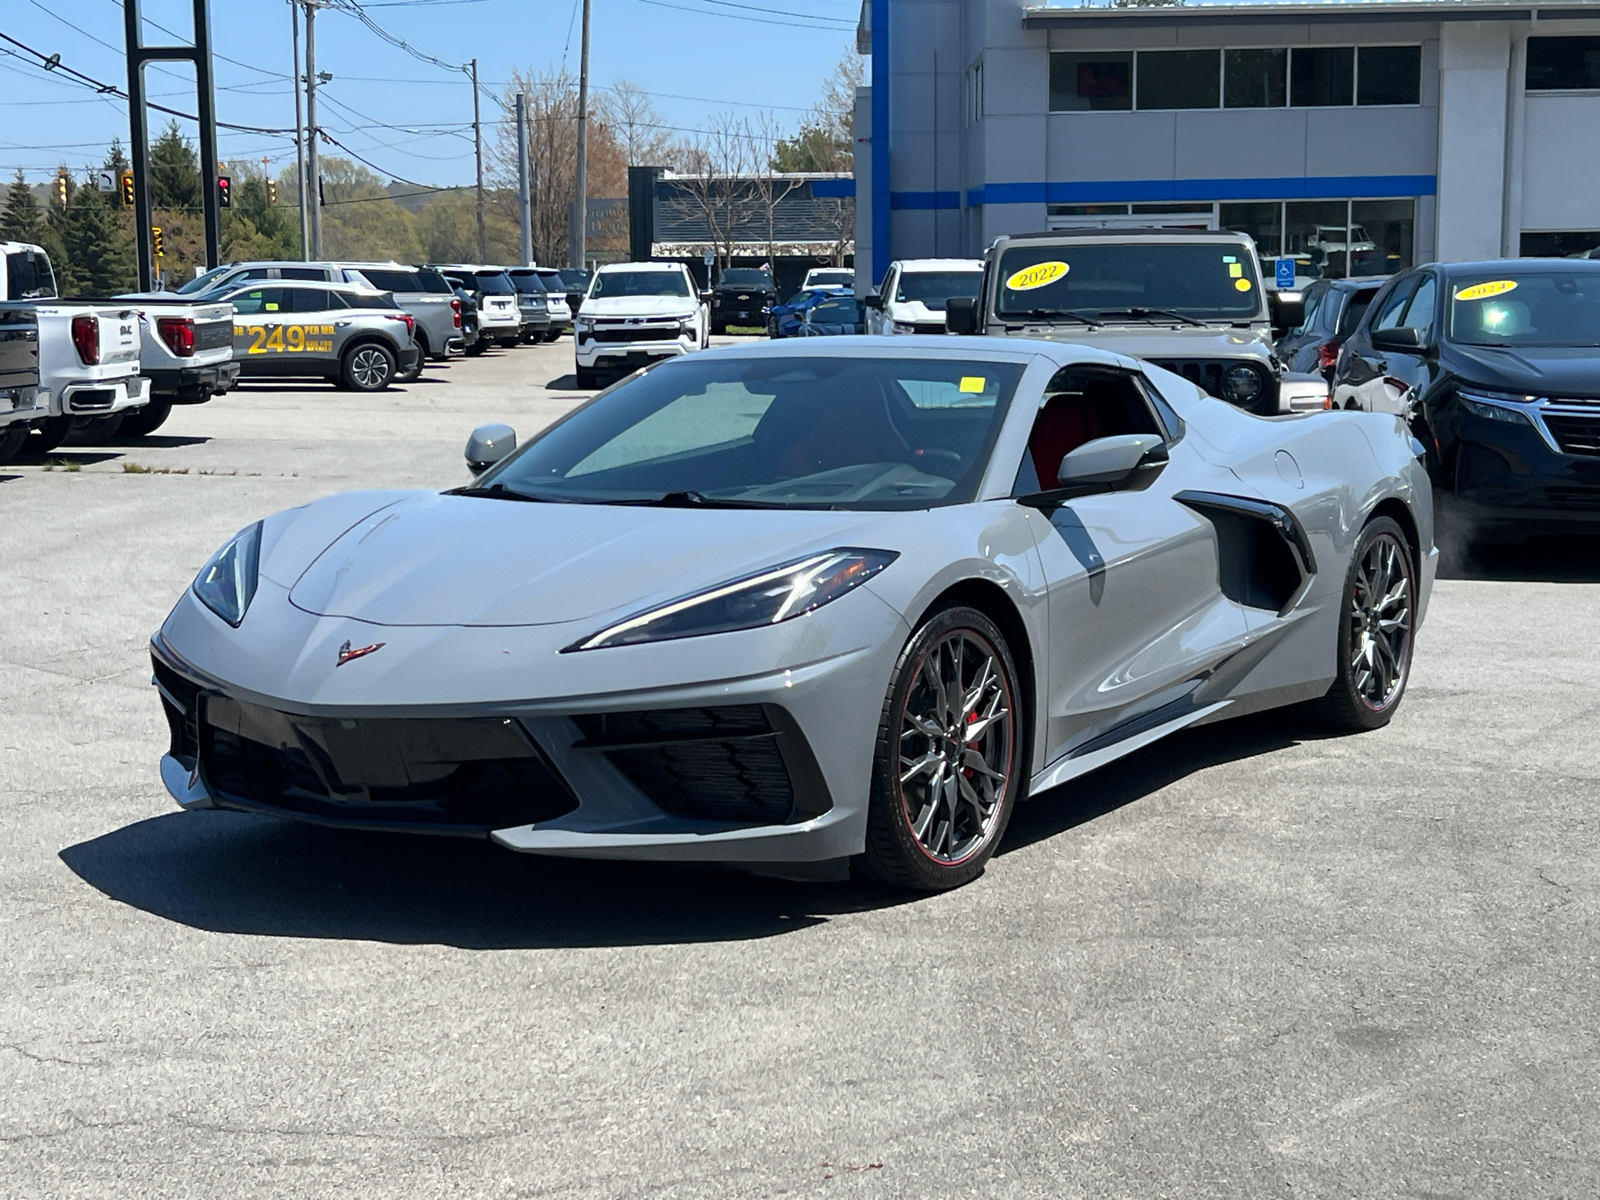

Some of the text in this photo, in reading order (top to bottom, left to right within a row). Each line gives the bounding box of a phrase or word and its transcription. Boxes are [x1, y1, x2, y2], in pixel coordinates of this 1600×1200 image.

[1019, 265, 1058, 287] 2022
[1470, 282, 1506, 298] 2024
[304, 325, 320, 335] PER
